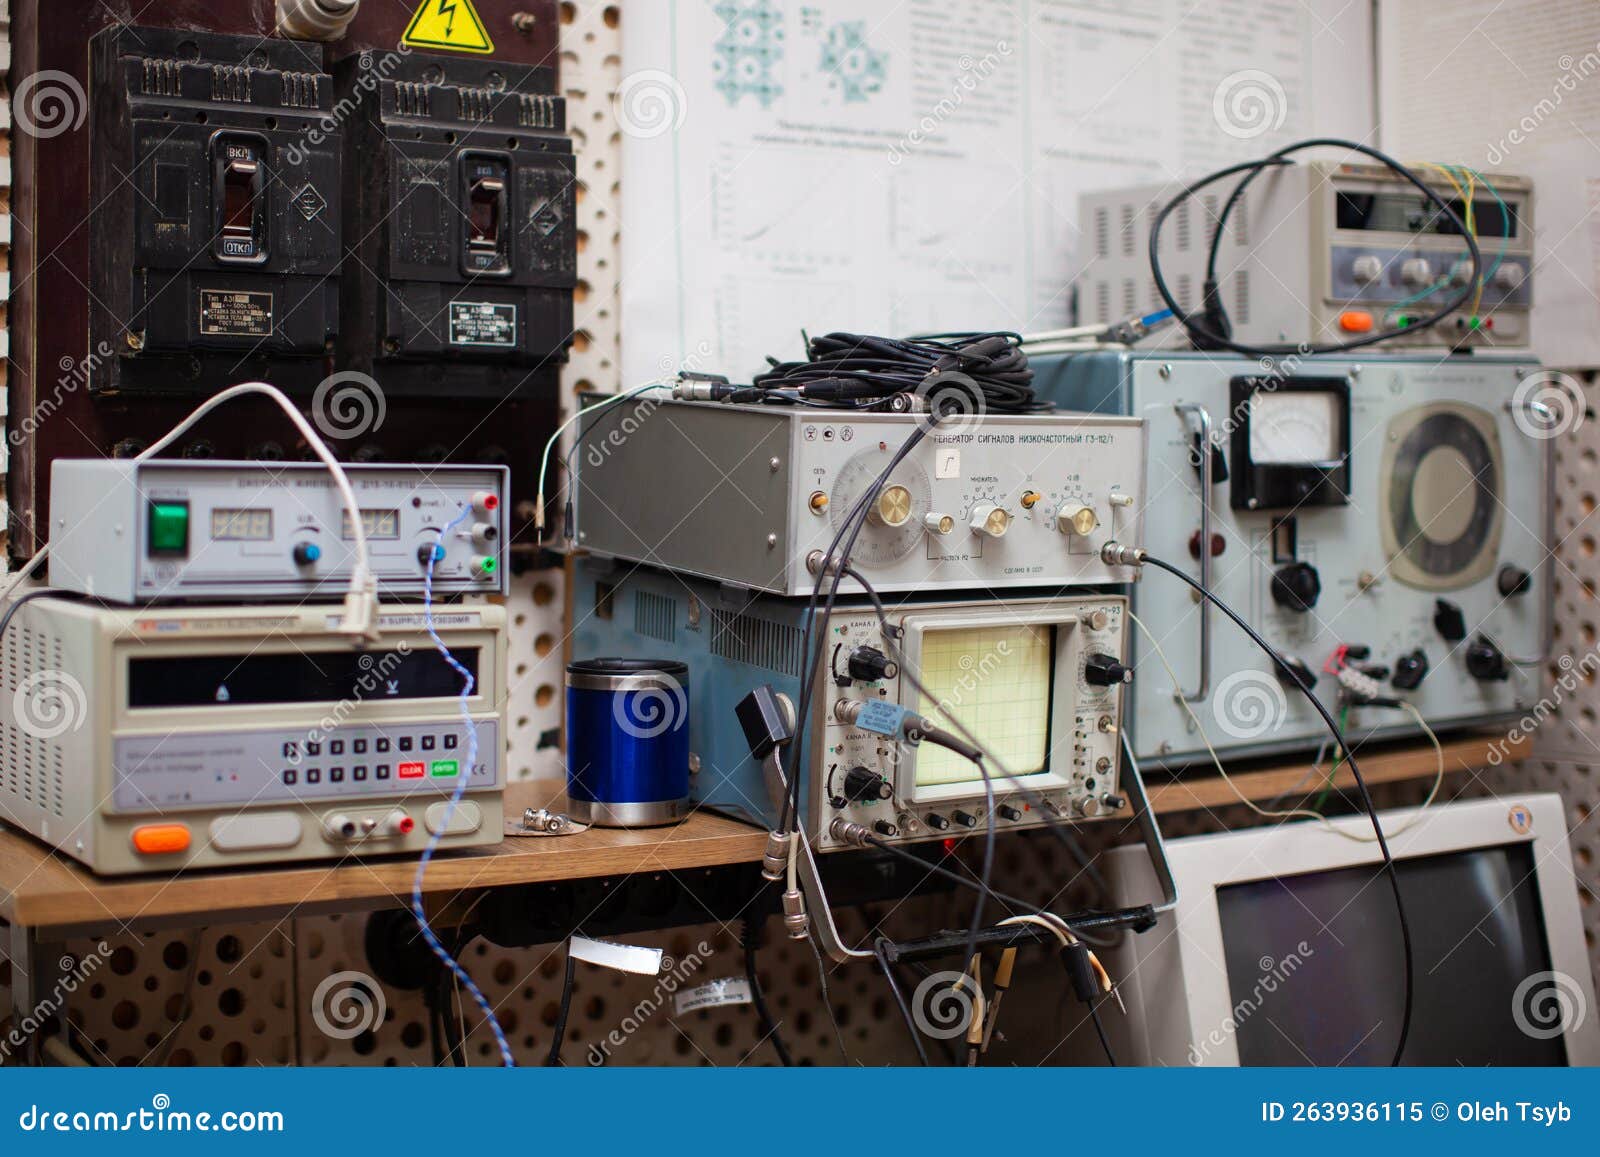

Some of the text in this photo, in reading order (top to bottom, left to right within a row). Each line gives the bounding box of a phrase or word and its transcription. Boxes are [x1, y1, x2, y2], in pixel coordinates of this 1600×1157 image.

[226, 242, 250, 251] ОТКЛ
[934, 434, 974, 444] ГЕНЕРАТОР
[978, 435, 1015, 443] СИГНАЛОВ
[1018, 434, 1082, 444] НИЗКОЧАСТОТНЫЙ
[401, 766, 423, 775] CLEAR
